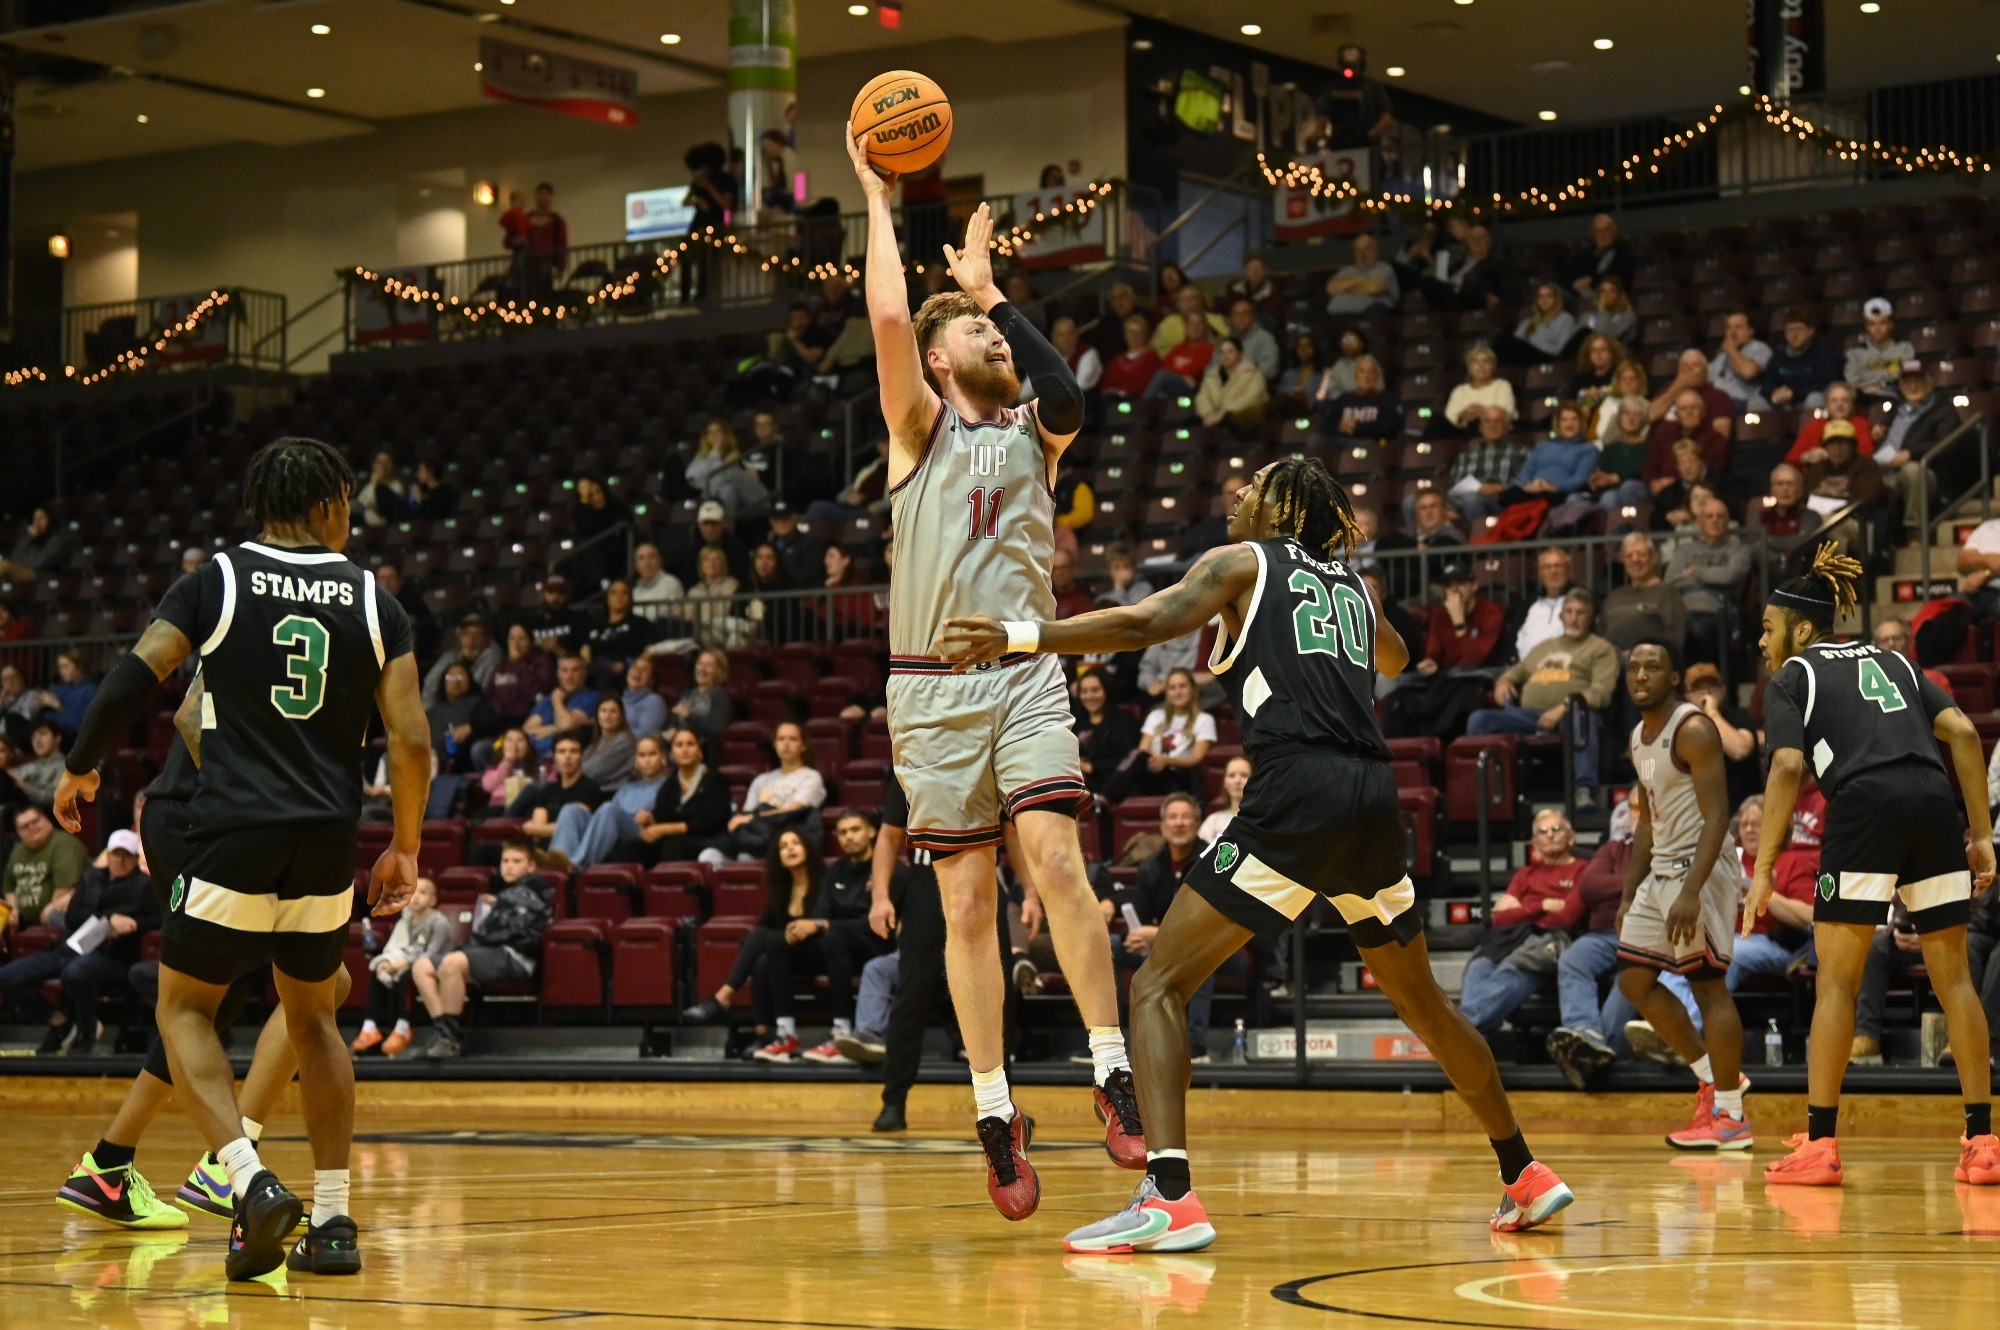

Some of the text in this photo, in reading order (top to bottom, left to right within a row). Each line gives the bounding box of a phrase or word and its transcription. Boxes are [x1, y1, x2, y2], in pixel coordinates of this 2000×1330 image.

[872, 87, 920, 115] NCAA
[872, 112, 941, 143] Wilson
[968, 445, 1008, 477] IUP
[968, 486, 1005, 540] 11
[251, 571, 354, 606] STAMPS
[1287, 568, 1368, 670] 20
[270, 614, 330, 720] 3
[1858, 657, 1908, 713] 4
[1641, 758, 1656, 780] IUP
[1284, 1039, 1334, 1051] TOOTA
